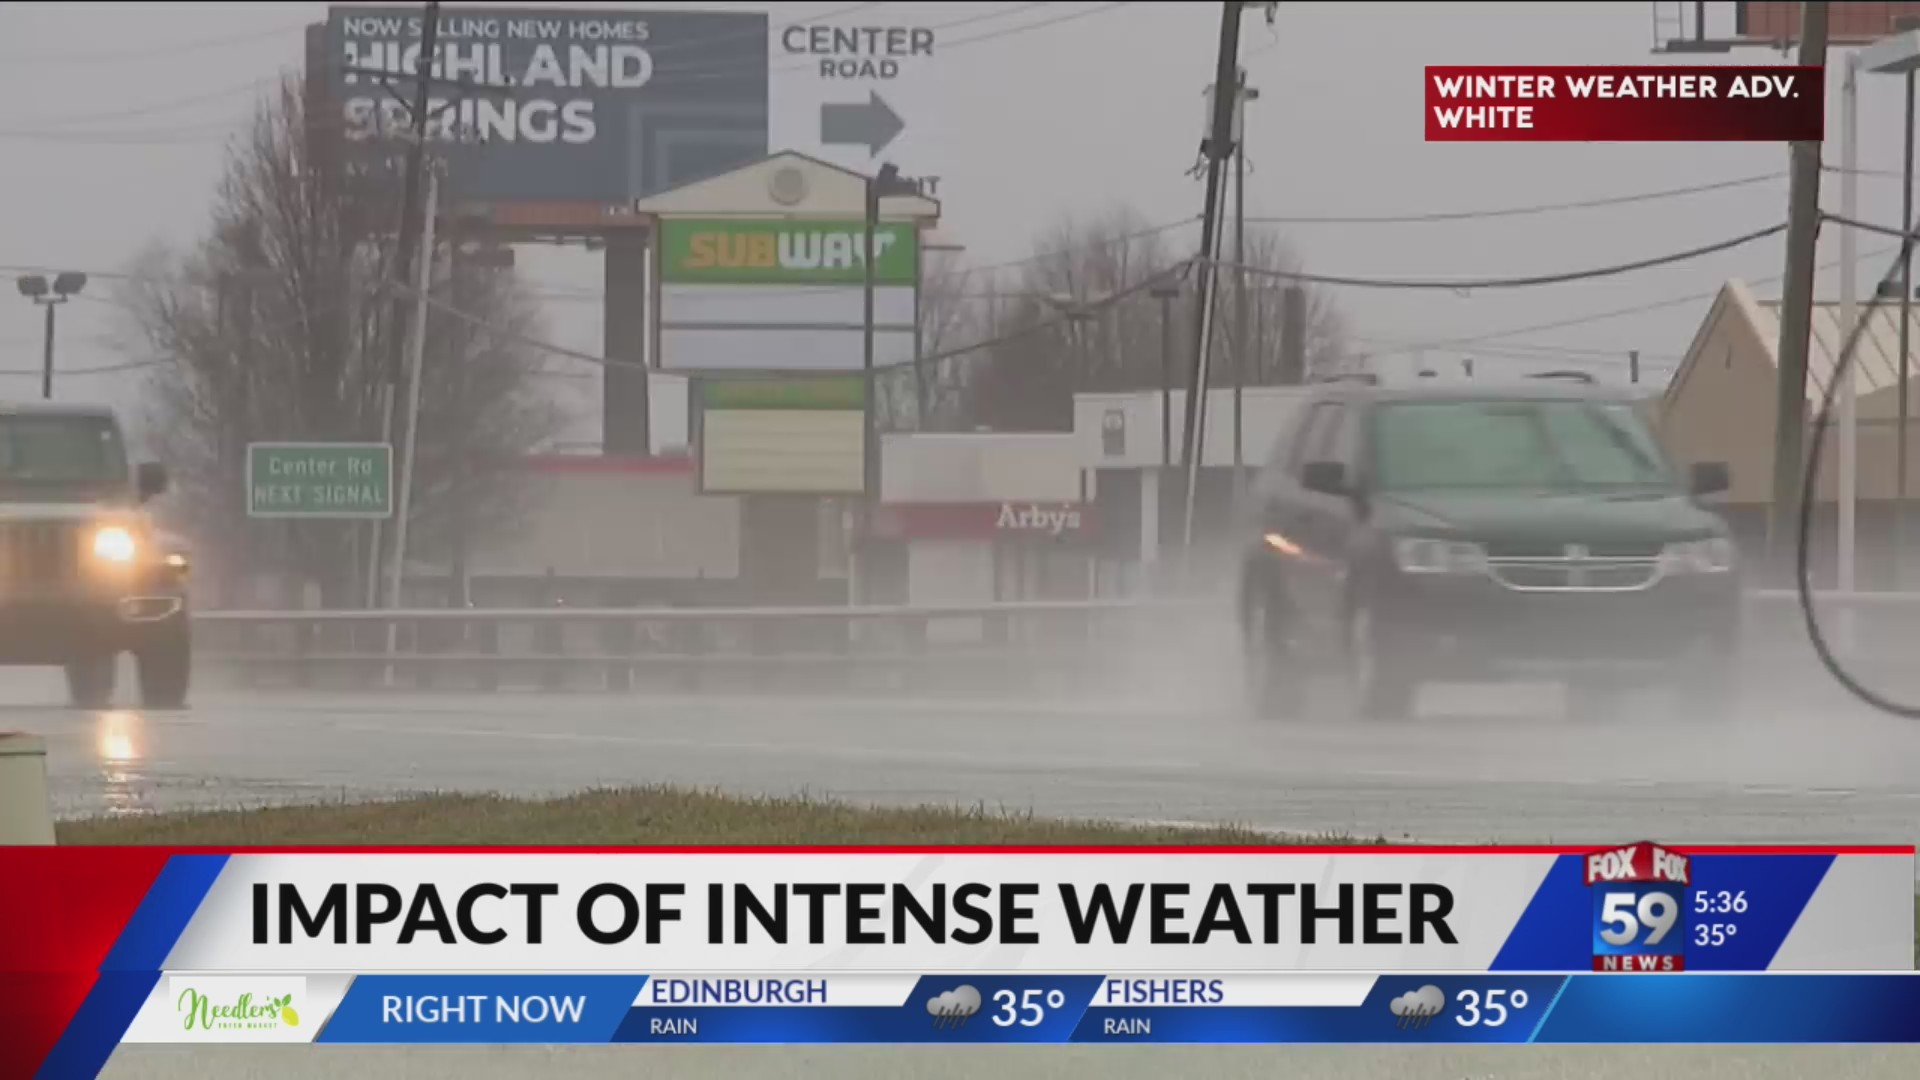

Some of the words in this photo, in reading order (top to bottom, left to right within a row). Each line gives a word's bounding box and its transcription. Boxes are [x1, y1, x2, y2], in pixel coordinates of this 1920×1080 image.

[343, 17, 400, 37] NOW
[407, 18, 500, 38] SLLING
[507, 20, 561, 39] NEW
[568, 21, 649, 41] HOMES
[782, 26, 934, 55] CENTER
[343, 41, 653, 88] HIGHLAND
[819, 59, 898, 79] ROAD
[344, 98, 597, 143] SPRINGS
[682, 231, 896, 270] SUBWAY
[269, 456, 336, 476] Center
[347, 457, 372, 476] Rd
[254, 483, 301, 504] NEXT
[312, 484, 382, 505] SIGNAL
[995, 503, 1081, 535] Arby's
